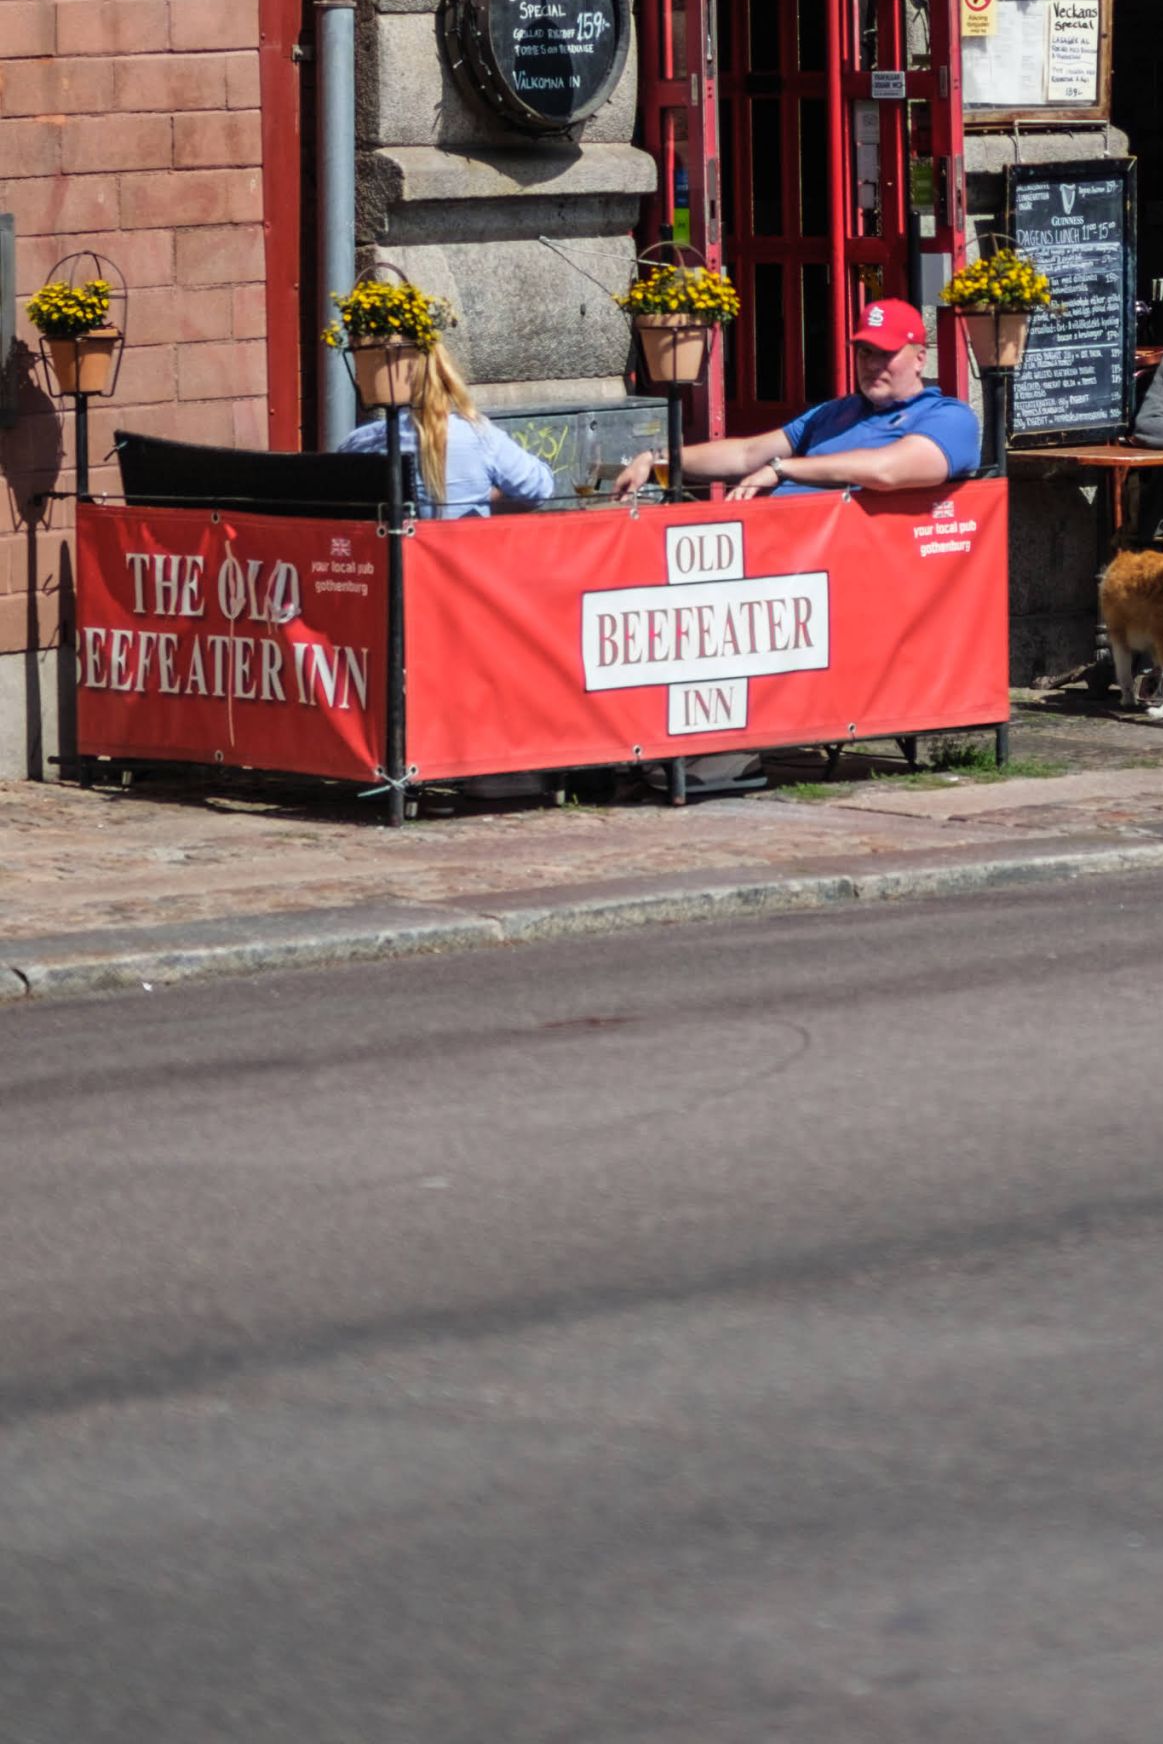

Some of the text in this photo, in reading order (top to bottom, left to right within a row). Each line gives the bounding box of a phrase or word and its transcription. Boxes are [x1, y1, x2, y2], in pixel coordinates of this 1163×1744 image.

[520, 2, 566, 19] SPECIAL
[1054, 1, 1098, 19] Veckans
[1051, 215, 1084, 227] GUINNESS
[1016, 229, 1054, 246] DAGENS
[1055, 227, 1080, 245] LUNCH
[913, 519, 977, 539] your local pub
[675, 532, 735, 574] OLD
[331, 560, 356, 574] local
[126, 552, 301, 624] THE OLD
[596, 595, 816, 668] BEEFEATER
[293, 642, 369, 711] INN
[683, 685, 735, 727] INN
